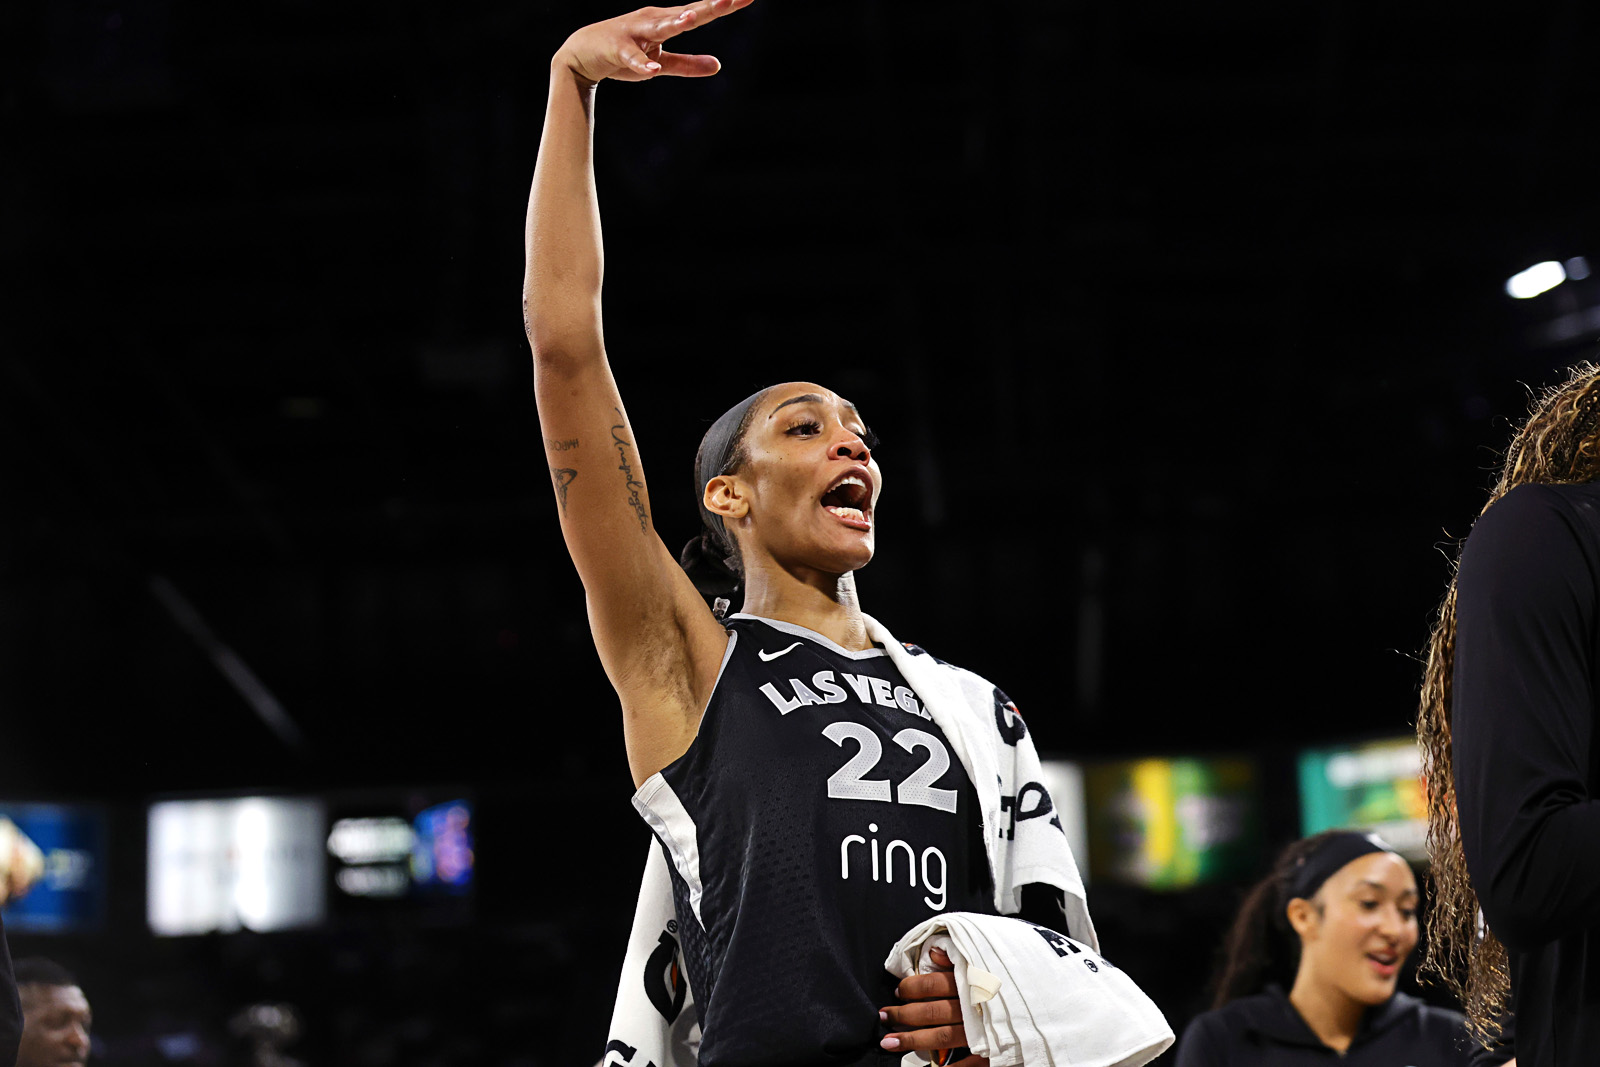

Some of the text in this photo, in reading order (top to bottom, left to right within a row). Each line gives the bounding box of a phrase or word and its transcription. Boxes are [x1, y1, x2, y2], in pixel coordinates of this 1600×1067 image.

[611, 406, 649, 536] Unapologetic
[759, 670, 848, 716] LAS
[822, 721, 958, 814] 22
[841, 823, 947, 911] ring
